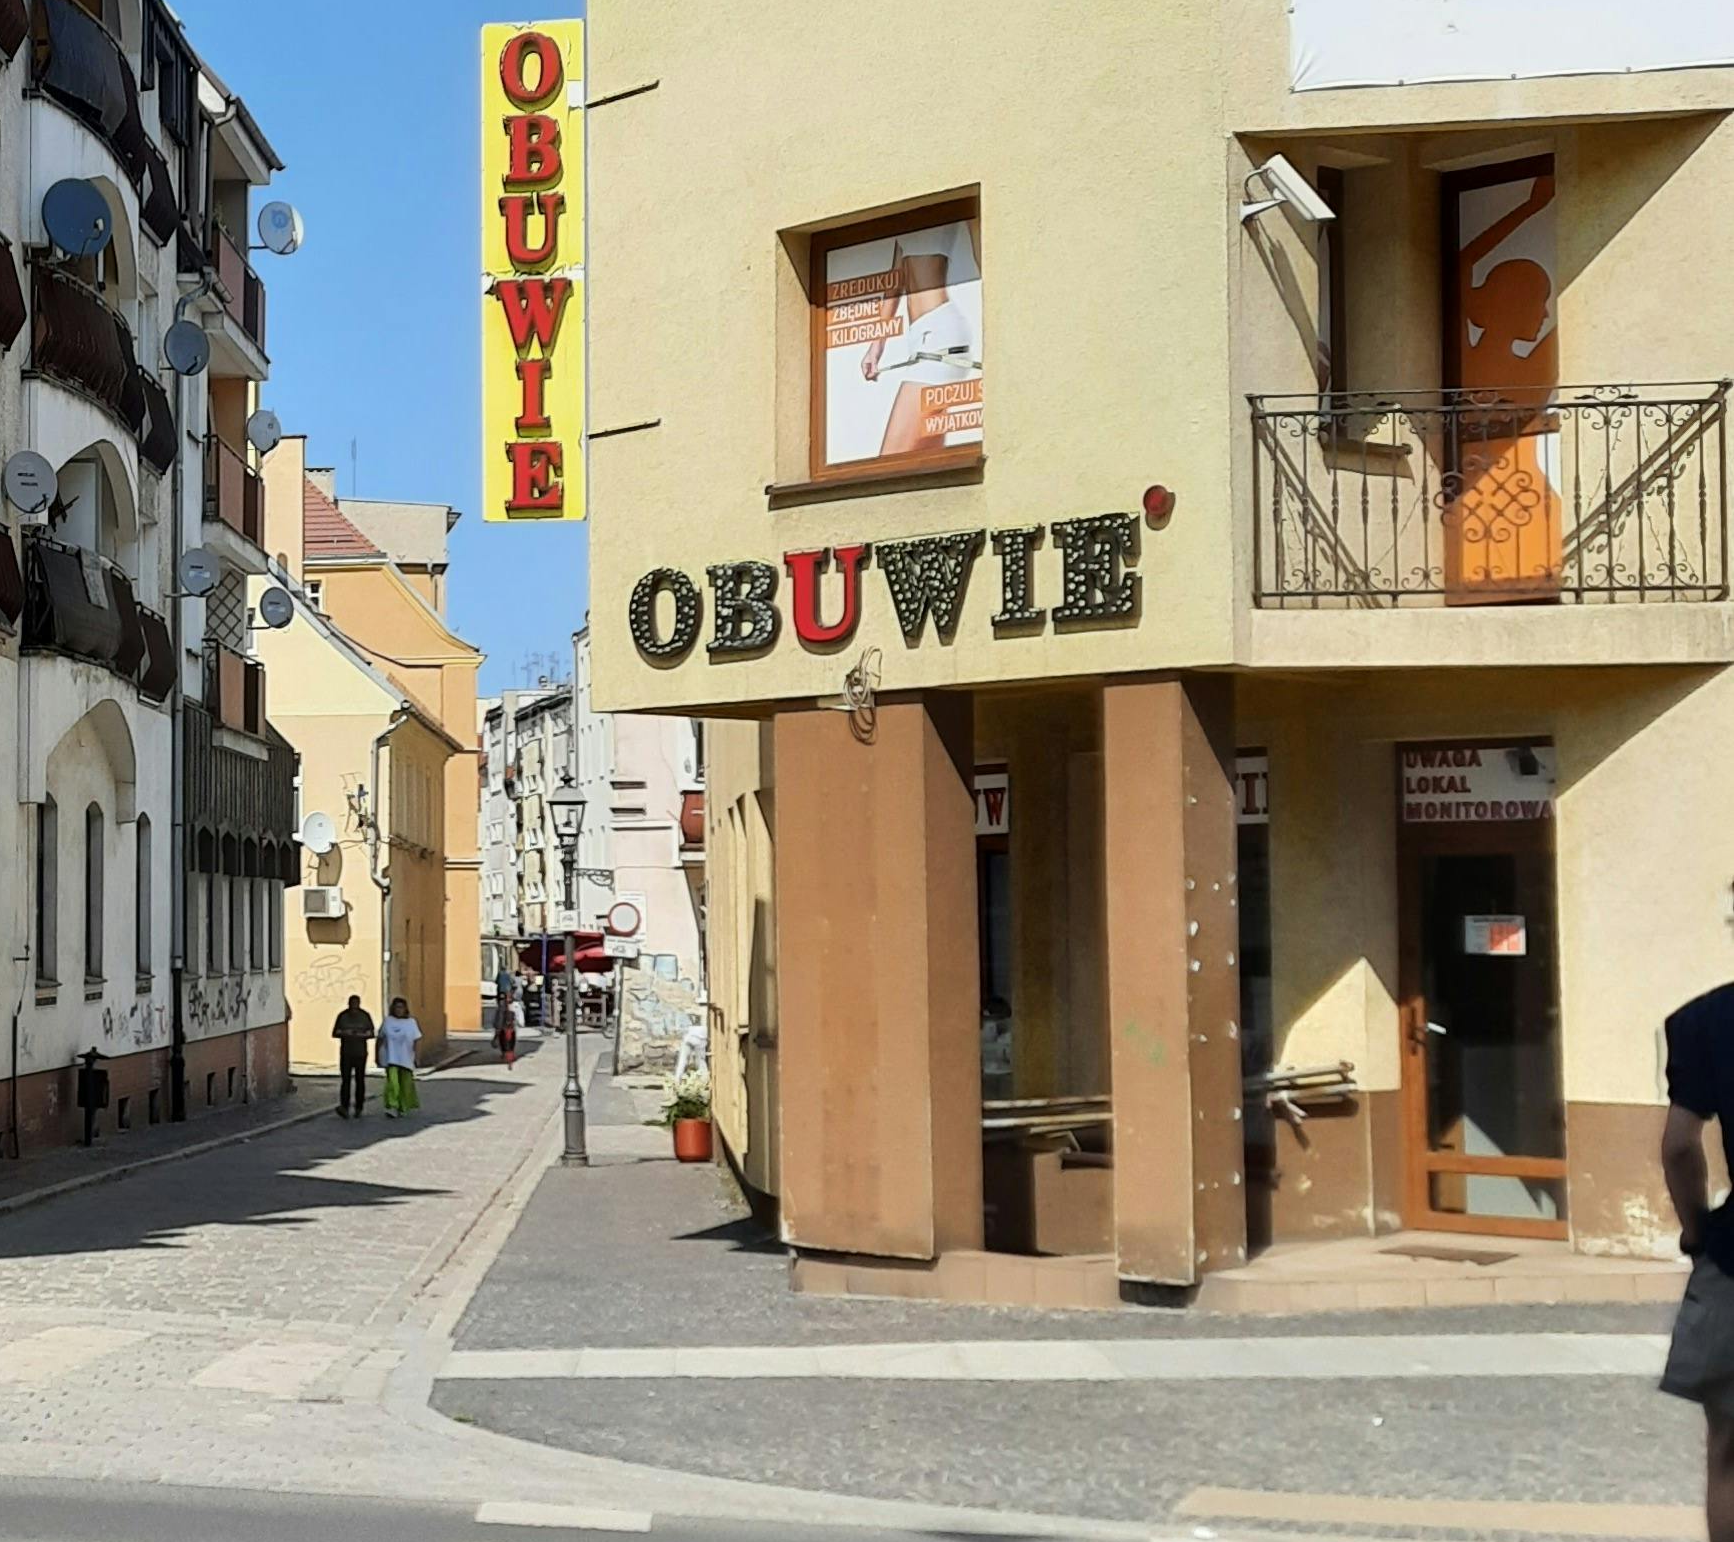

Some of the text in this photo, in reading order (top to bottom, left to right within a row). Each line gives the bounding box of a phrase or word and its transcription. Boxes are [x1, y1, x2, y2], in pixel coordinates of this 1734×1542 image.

[497, 31, 572, 519] OBUWIE
[831, 271, 901, 299] ZREDUKUJ
[832, 299, 880, 322] ZBĘDNE
[831, 317, 902, 346] KILOGRAMY
[925, 381, 974, 406] POCZUJ
[629, 512, 1144, 665] OBUWIE
[1404, 749, 1483, 768] UWAGA
[1404, 775, 1472, 794] LOKAL
